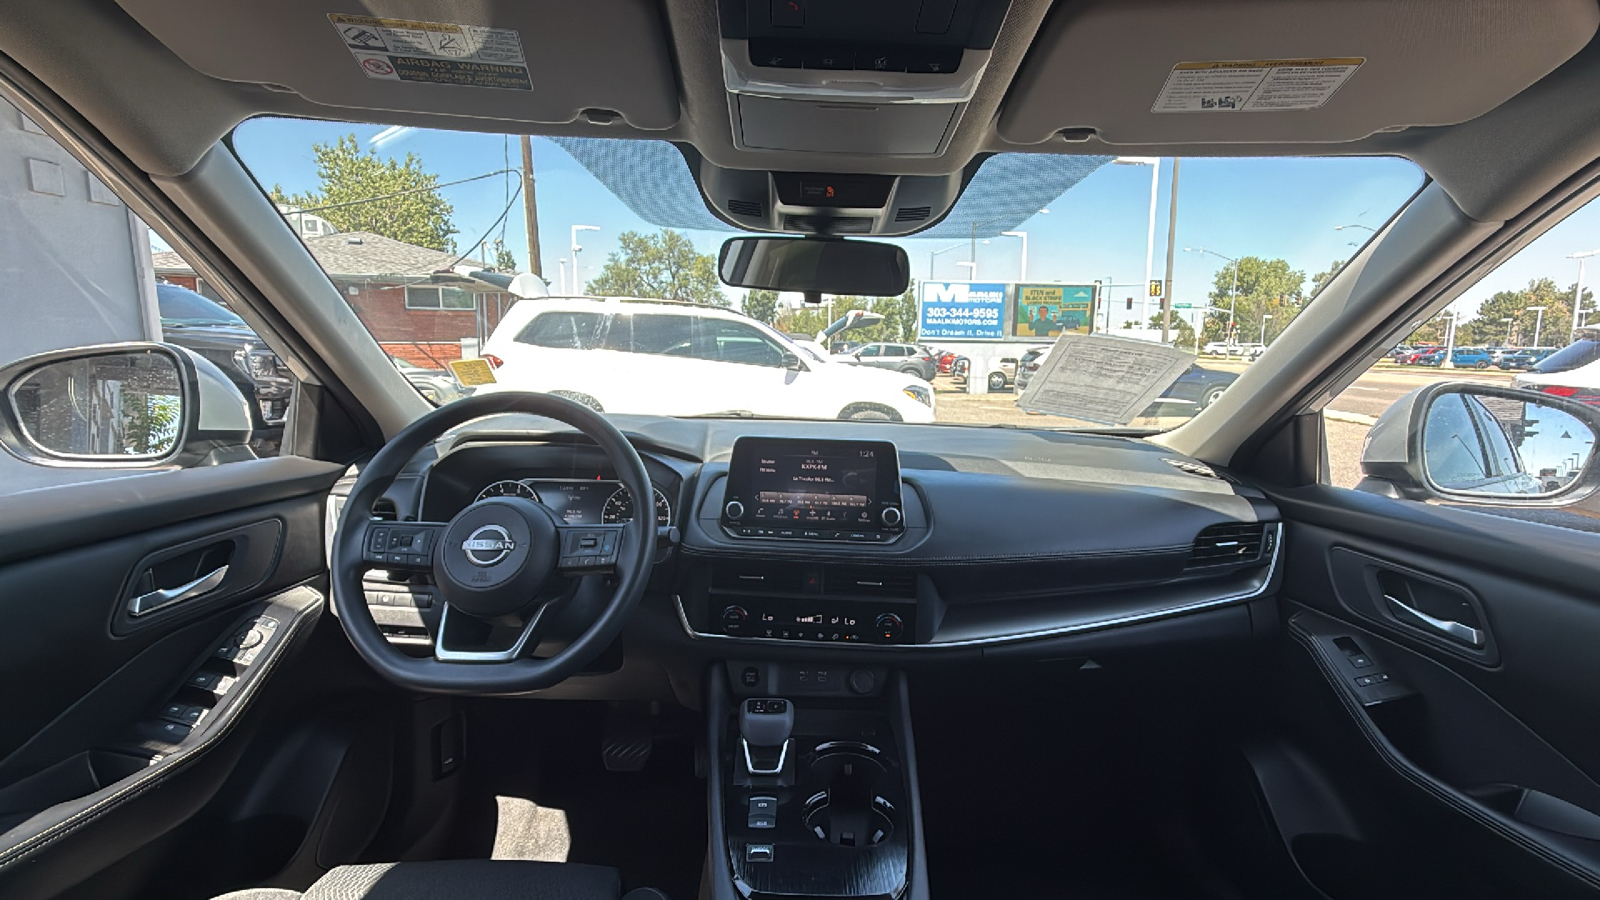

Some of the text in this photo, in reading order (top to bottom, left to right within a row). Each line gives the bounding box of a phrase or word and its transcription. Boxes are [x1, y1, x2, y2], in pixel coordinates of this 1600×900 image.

[397, 57, 451, 69] AIRBAG
[458, 62, 523, 74] WARNING
[926, 307, 999, 318] 303-344-9595
[921, 328, 940, 336] Don't
[860, 450, 874, 458] 1:24
[463, 541, 515, 550] NISSAN
